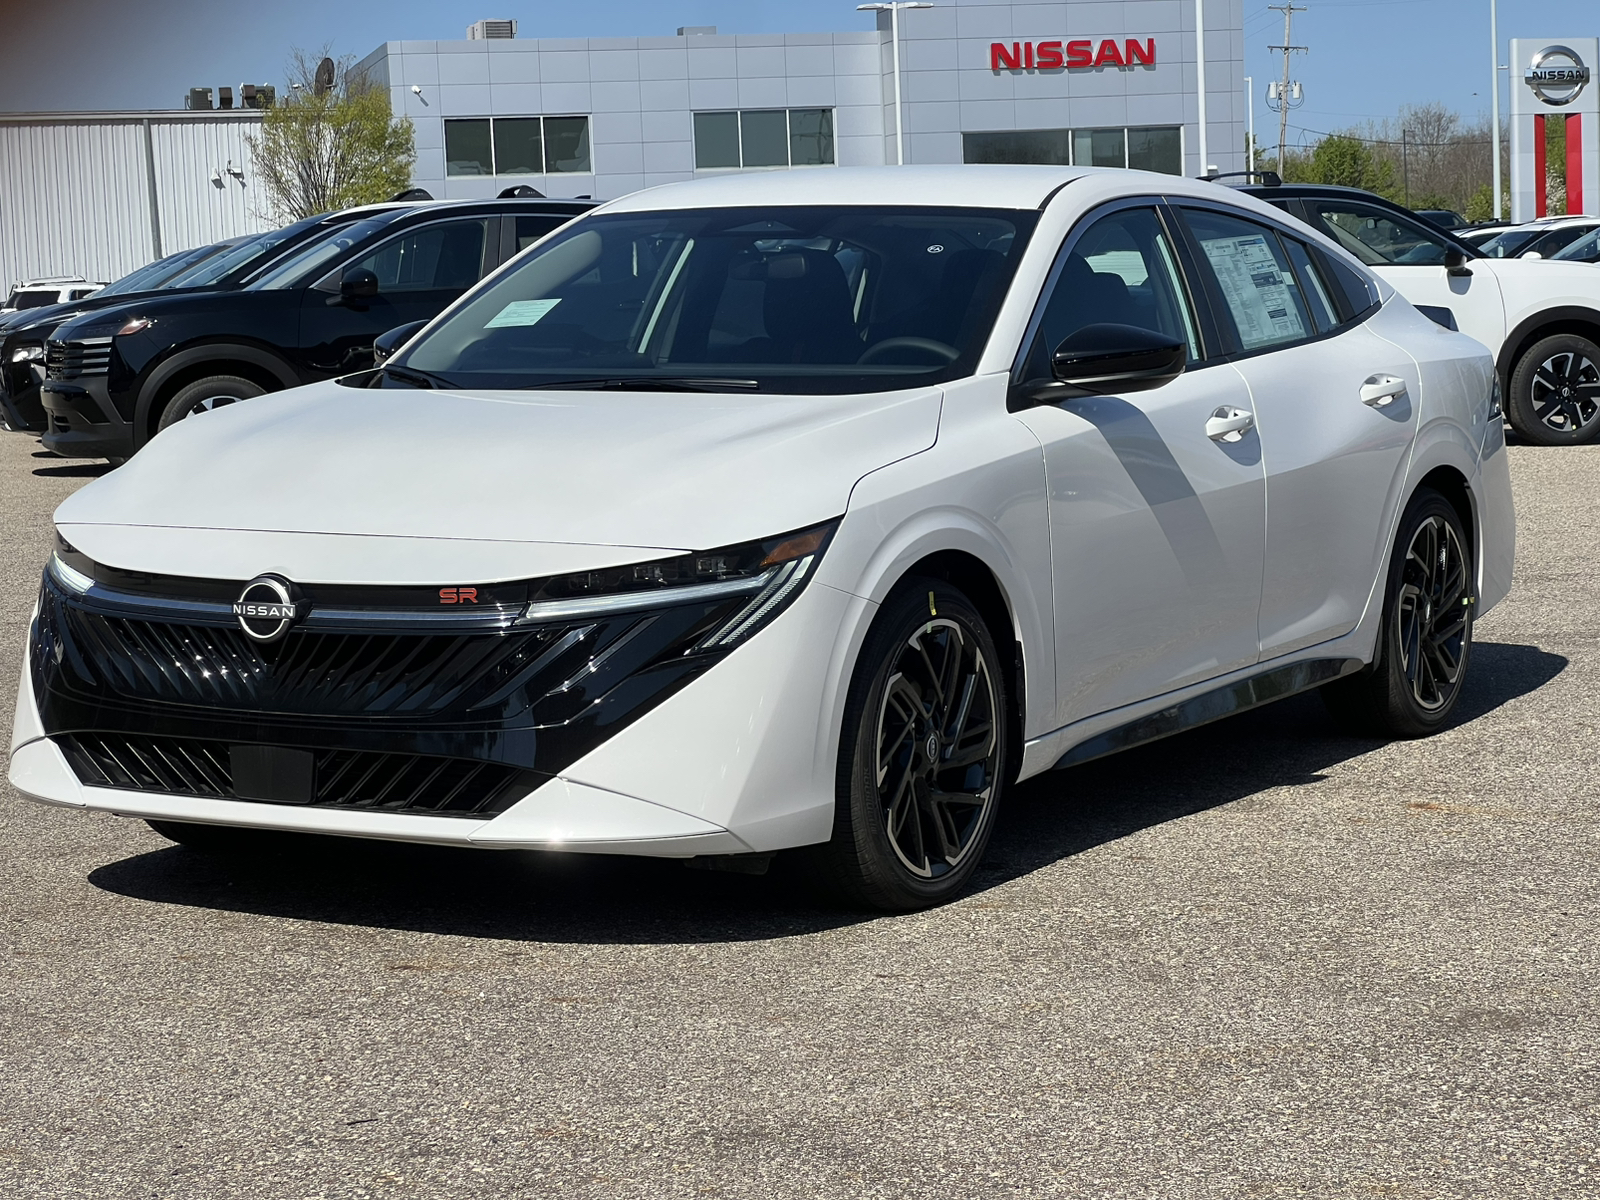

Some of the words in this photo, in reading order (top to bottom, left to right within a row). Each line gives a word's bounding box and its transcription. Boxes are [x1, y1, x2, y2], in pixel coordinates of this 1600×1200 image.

[991, 38, 1154, 70] NISSAN
[1532, 70, 1585, 80] NISSAN
[439, 587, 478, 603] SR
[233, 604, 294, 617] NISSAN
